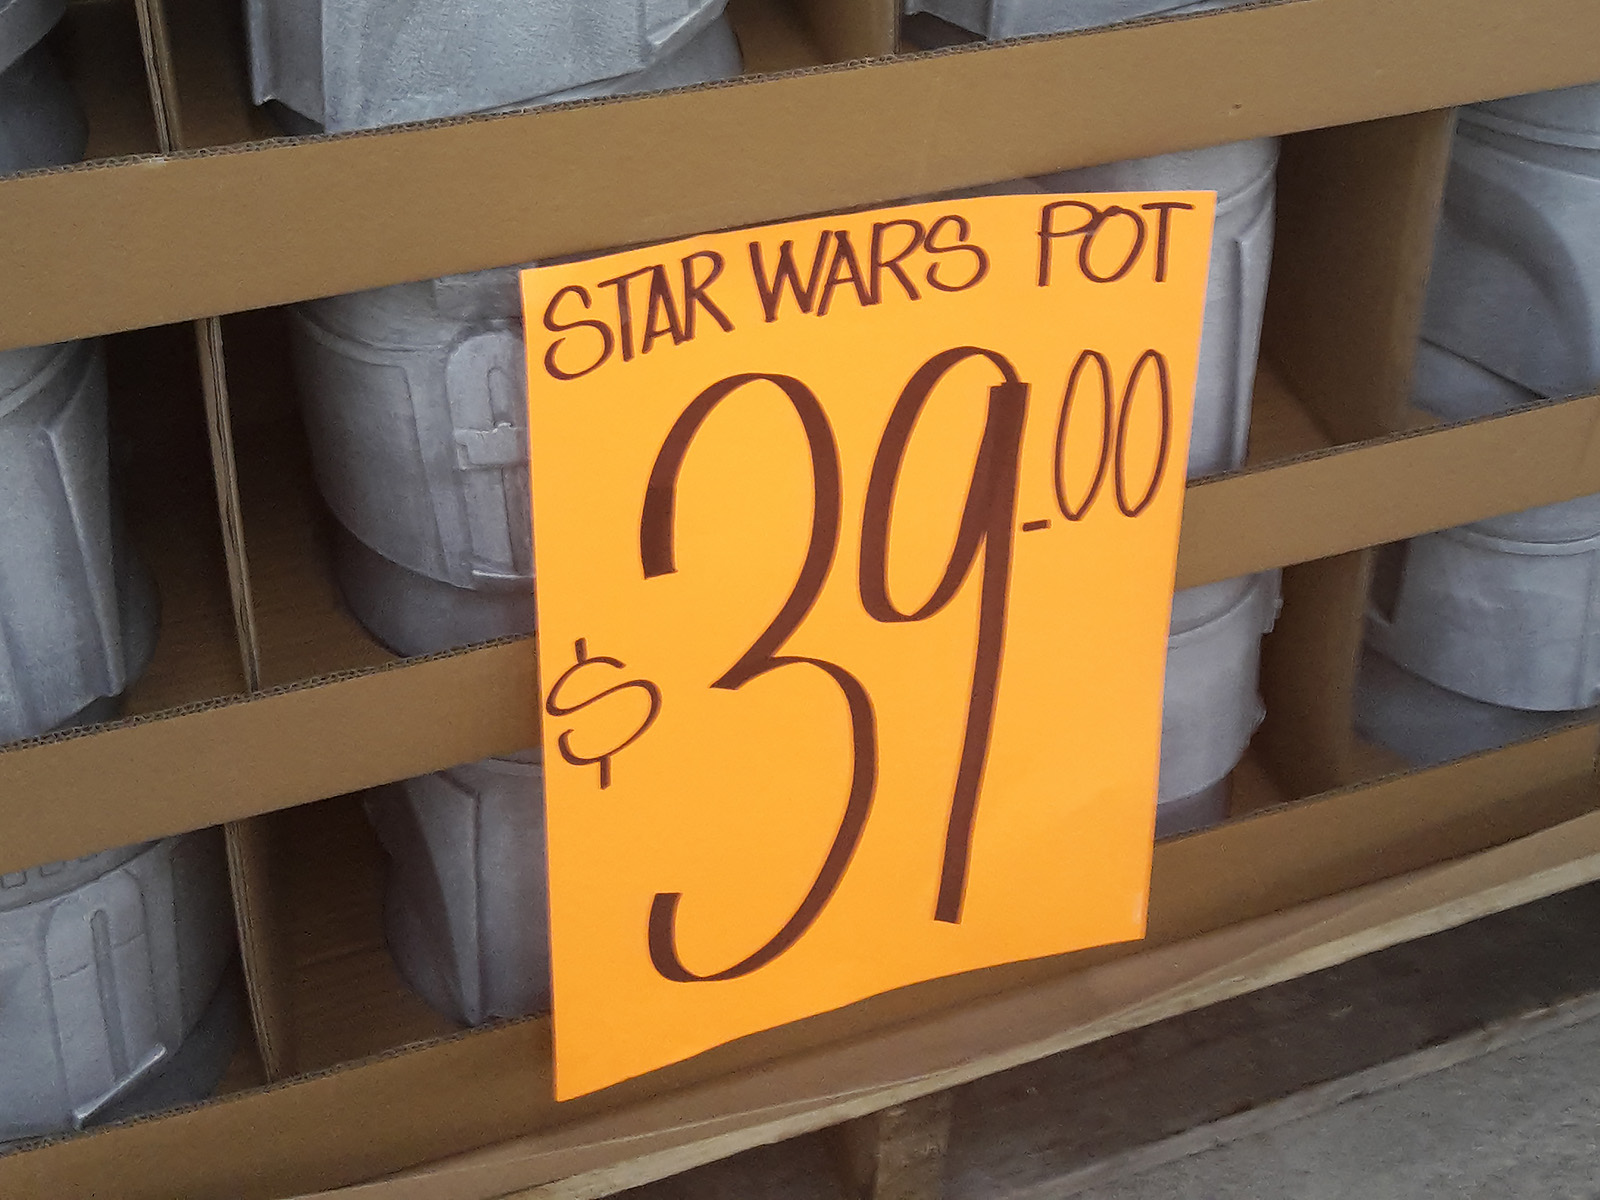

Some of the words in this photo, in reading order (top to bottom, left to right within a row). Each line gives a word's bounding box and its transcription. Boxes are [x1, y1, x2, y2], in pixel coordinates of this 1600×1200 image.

[543, 250, 734, 381] STAR
[749, 214, 989, 324] WARS
[1037, 200, 1196, 287] POT
